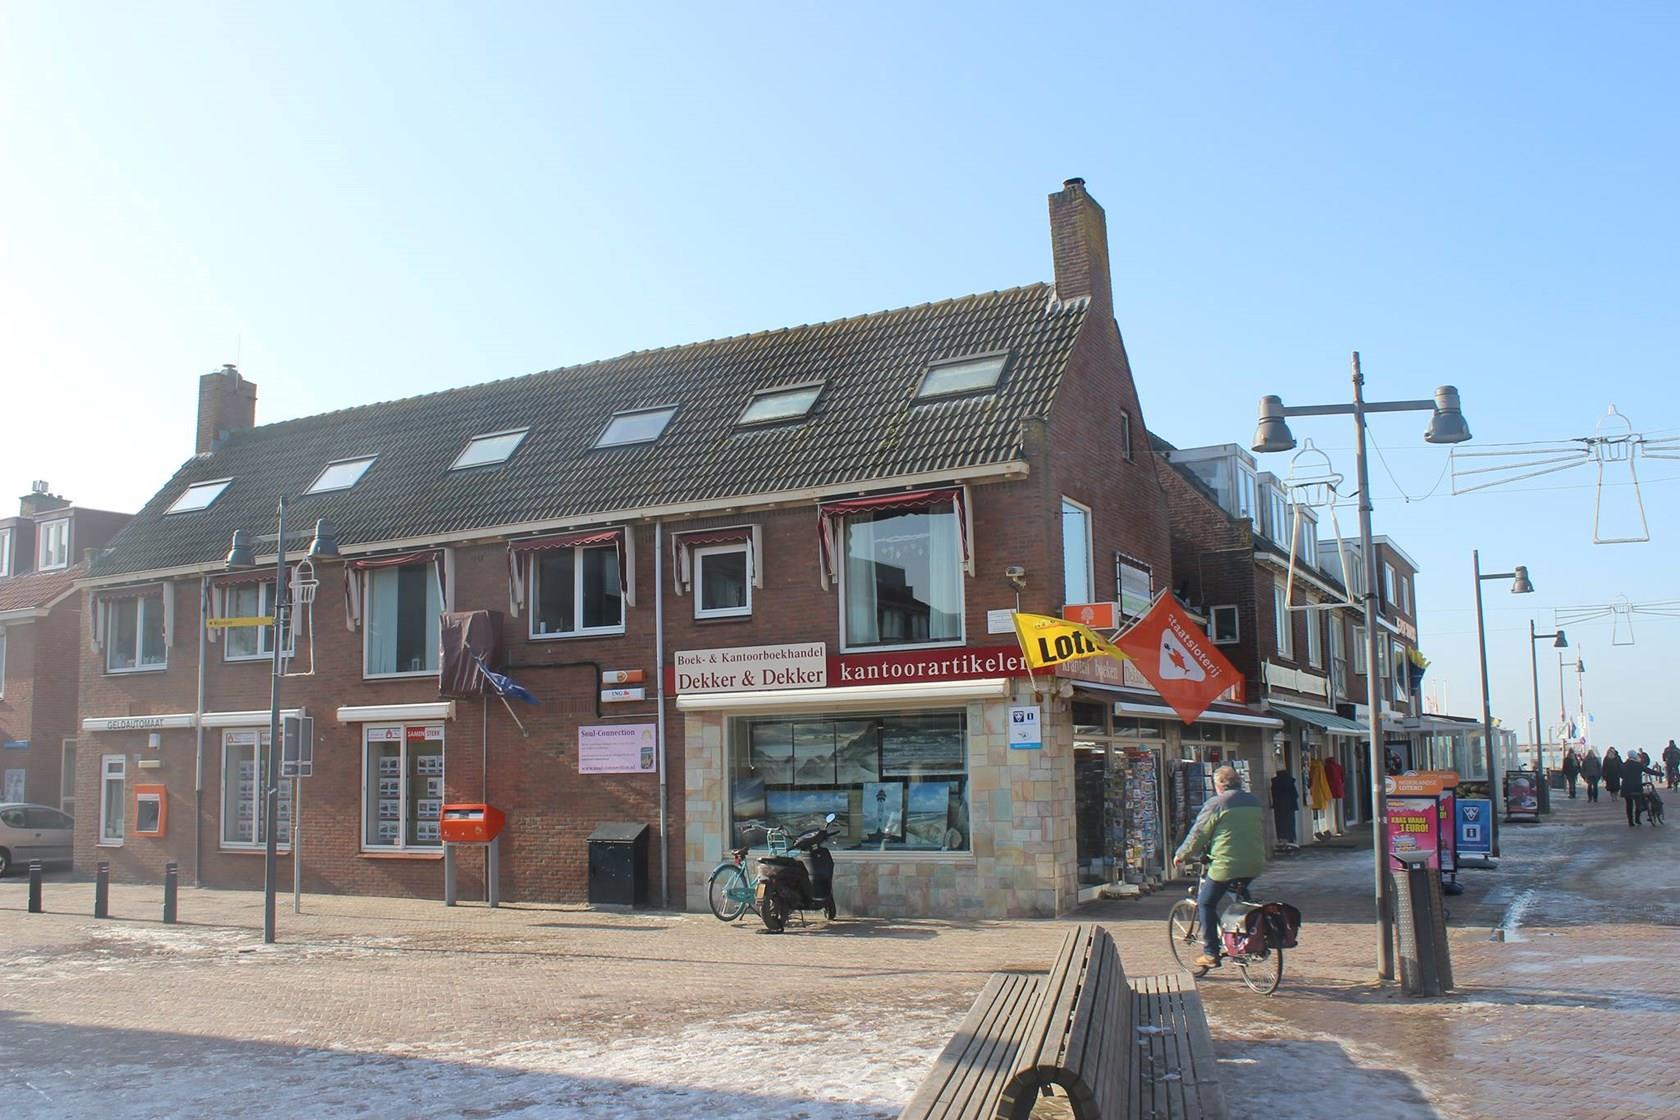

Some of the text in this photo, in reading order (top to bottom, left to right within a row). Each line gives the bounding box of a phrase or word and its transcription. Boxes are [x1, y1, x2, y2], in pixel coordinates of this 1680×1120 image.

[678, 646, 823, 665] Boek- & Kantoorboekhandel
[1169, 614, 1222, 678] staatsloterij
[679, 667, 824, 690] Dekker & Dekker
[107, 718, 164, 730] GELDAUTOMAAT
[1400, 824, 1429, 832] 1 EURO!
